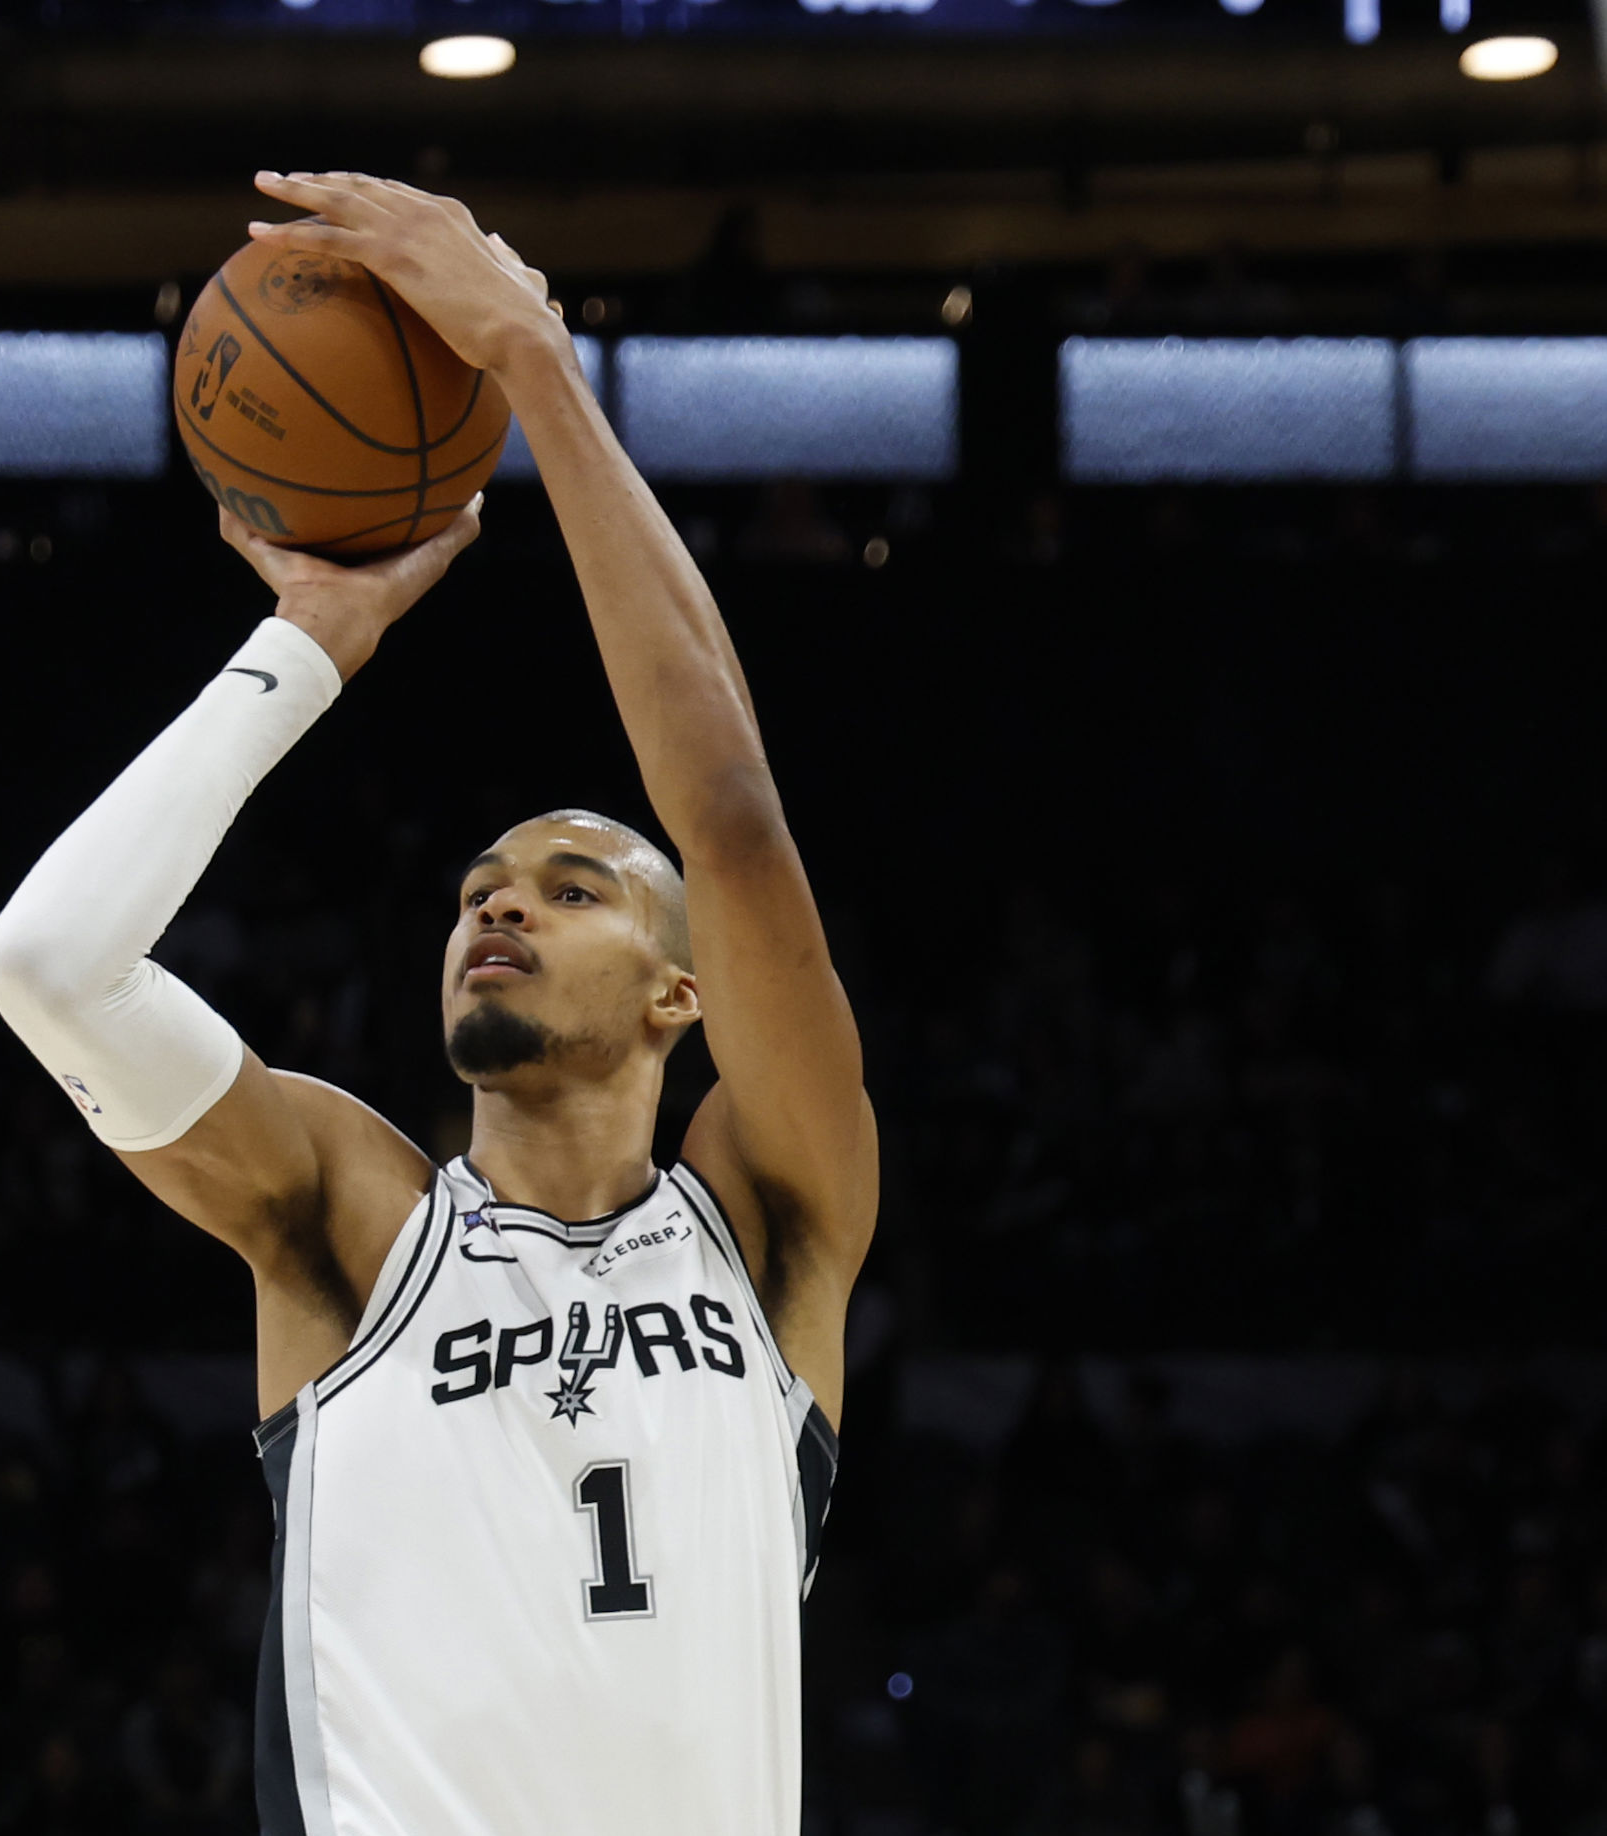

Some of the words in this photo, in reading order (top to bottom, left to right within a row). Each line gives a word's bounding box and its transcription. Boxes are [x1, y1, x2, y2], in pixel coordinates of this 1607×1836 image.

[602, 1225, 678, 1264] LEDGER
[430, 1293, 747, 1428] SPURS
[572, 1458, 657, 1623] 1
